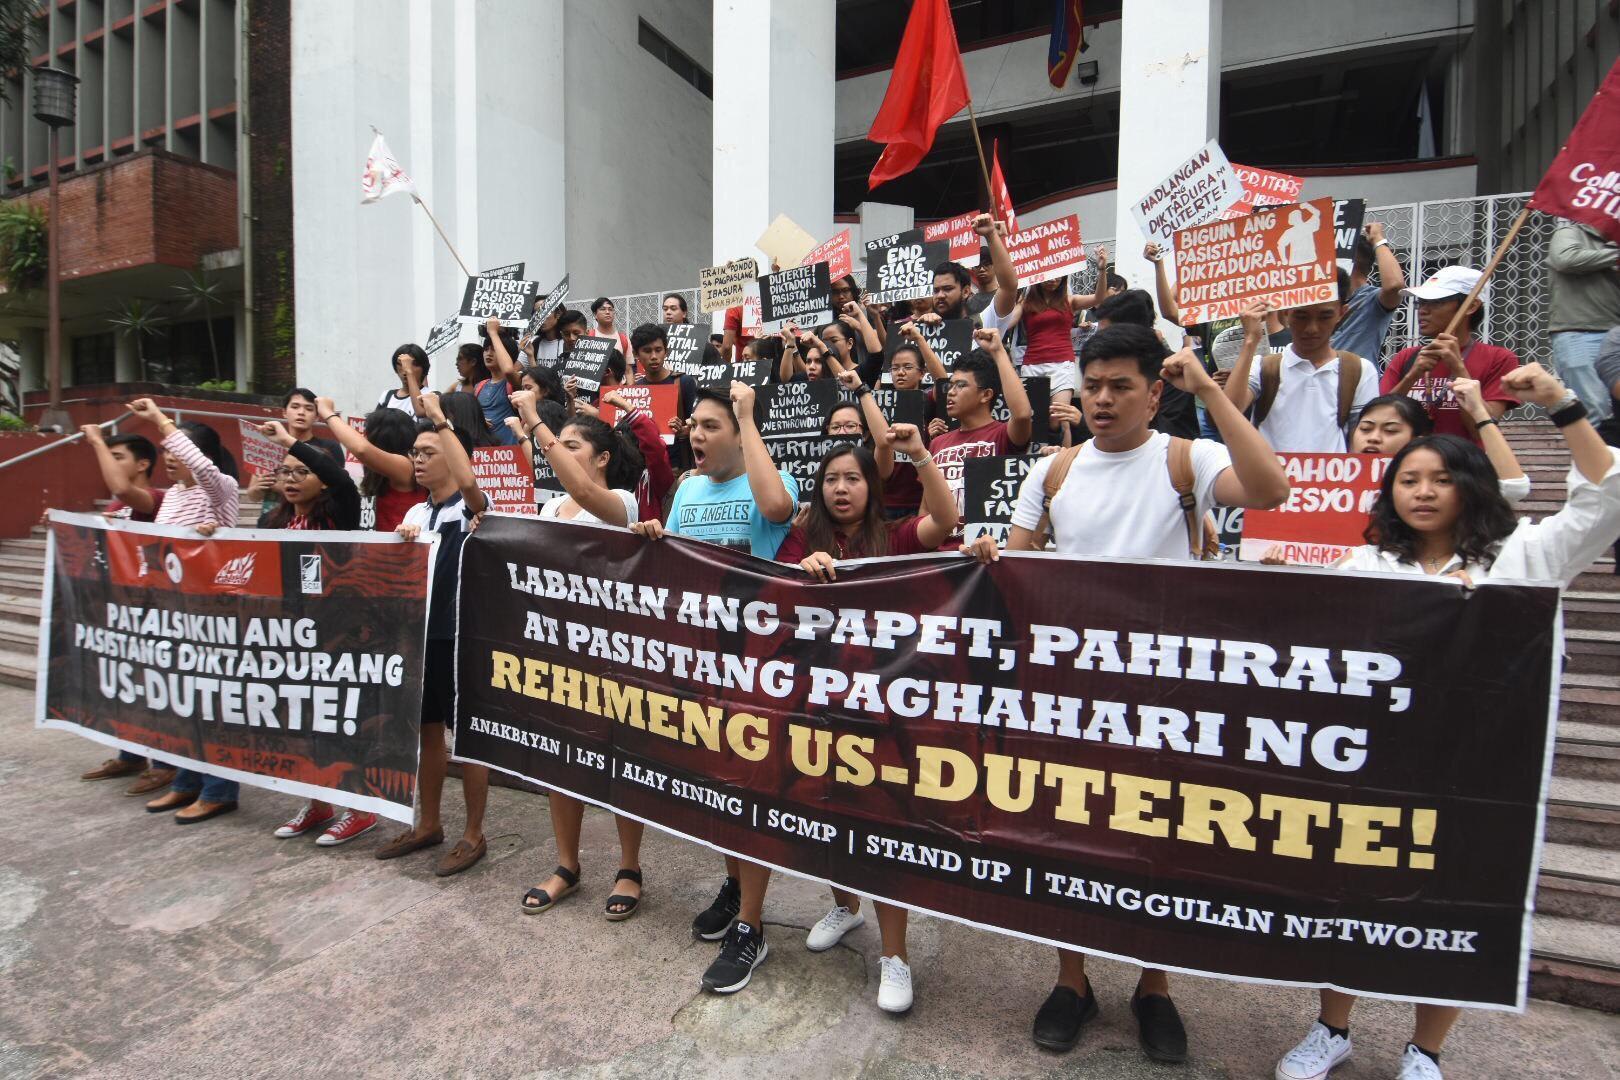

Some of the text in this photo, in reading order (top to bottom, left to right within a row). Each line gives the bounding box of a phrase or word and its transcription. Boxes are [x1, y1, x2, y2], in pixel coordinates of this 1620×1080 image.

[1141, 150, 1210, 215] HADLANGAN
[1149, 174, 1216, 234] DIKTADURA
[1161, 180, 1227, 239] DUTERTE!
[1571, 186, 1620, 219] STU
[1181, 213, 1277, 250] BIGUIN ANG
[868, 235, 900, 250] STOP
[1048, 235, 1070, 250] ANG
[1176, 234, 1264, 267] PASISTANG
[887, 245, 923, 264] END
[769, 264, 816, 285] DUTERTE!
[878, 257, 926, 278] STATE
[1180, 250, 1282, 284] DIKTADURA,
[475, 277, 533, 294] DUTERTE
[707, 285, 743, 299] IBASURA
[769, 277, 816, 295] DIKTADOR!
[1180, 261, 1332, 305] DUTERTERORISTA!
[473, 291, 524, 305] PASISTA
[771, 290, 809, 305] PASISTA!
[870, 287, 933, 304] TANGGULA
[471, 301, 522, 312] DIKTADOR
[772, 294, 829, 318] PABAGSAKIN!
[667, 325, 694, 337] LIFT
[667, 337, 699, 350] RTIAL
[698, 362, 757, 381] STOP THE
[778, 383, 807, 397] STOP
[771, 394, 811, 408] LUMAD
[769, 404, 819, 419] KILLINGS!
[472, 463, 521, 476] NATIONAL
[680, 505, 750, 524] LOS ANGELES
[106, 602, 317, 648] PATALSIKIN ANG
[506, 562, 1412, 713] LABANAN ANG PAPET, PAHIRAP,
[74, 623, 404, 687] PASISTANG DIKTADURANG
[98, 657, 361, 736] US-DUTERTE!
[523, 610, 1369, 772] AT PASISTANG PAGHAHARI NG
[491, 650, 1438, 870] REHIMENG US-DUTERTE!
[469, 716, 1479, 953] ANAKBAYAN LFS ALAY SINING SCMP STAND UP TANGGULAN NETWORK
